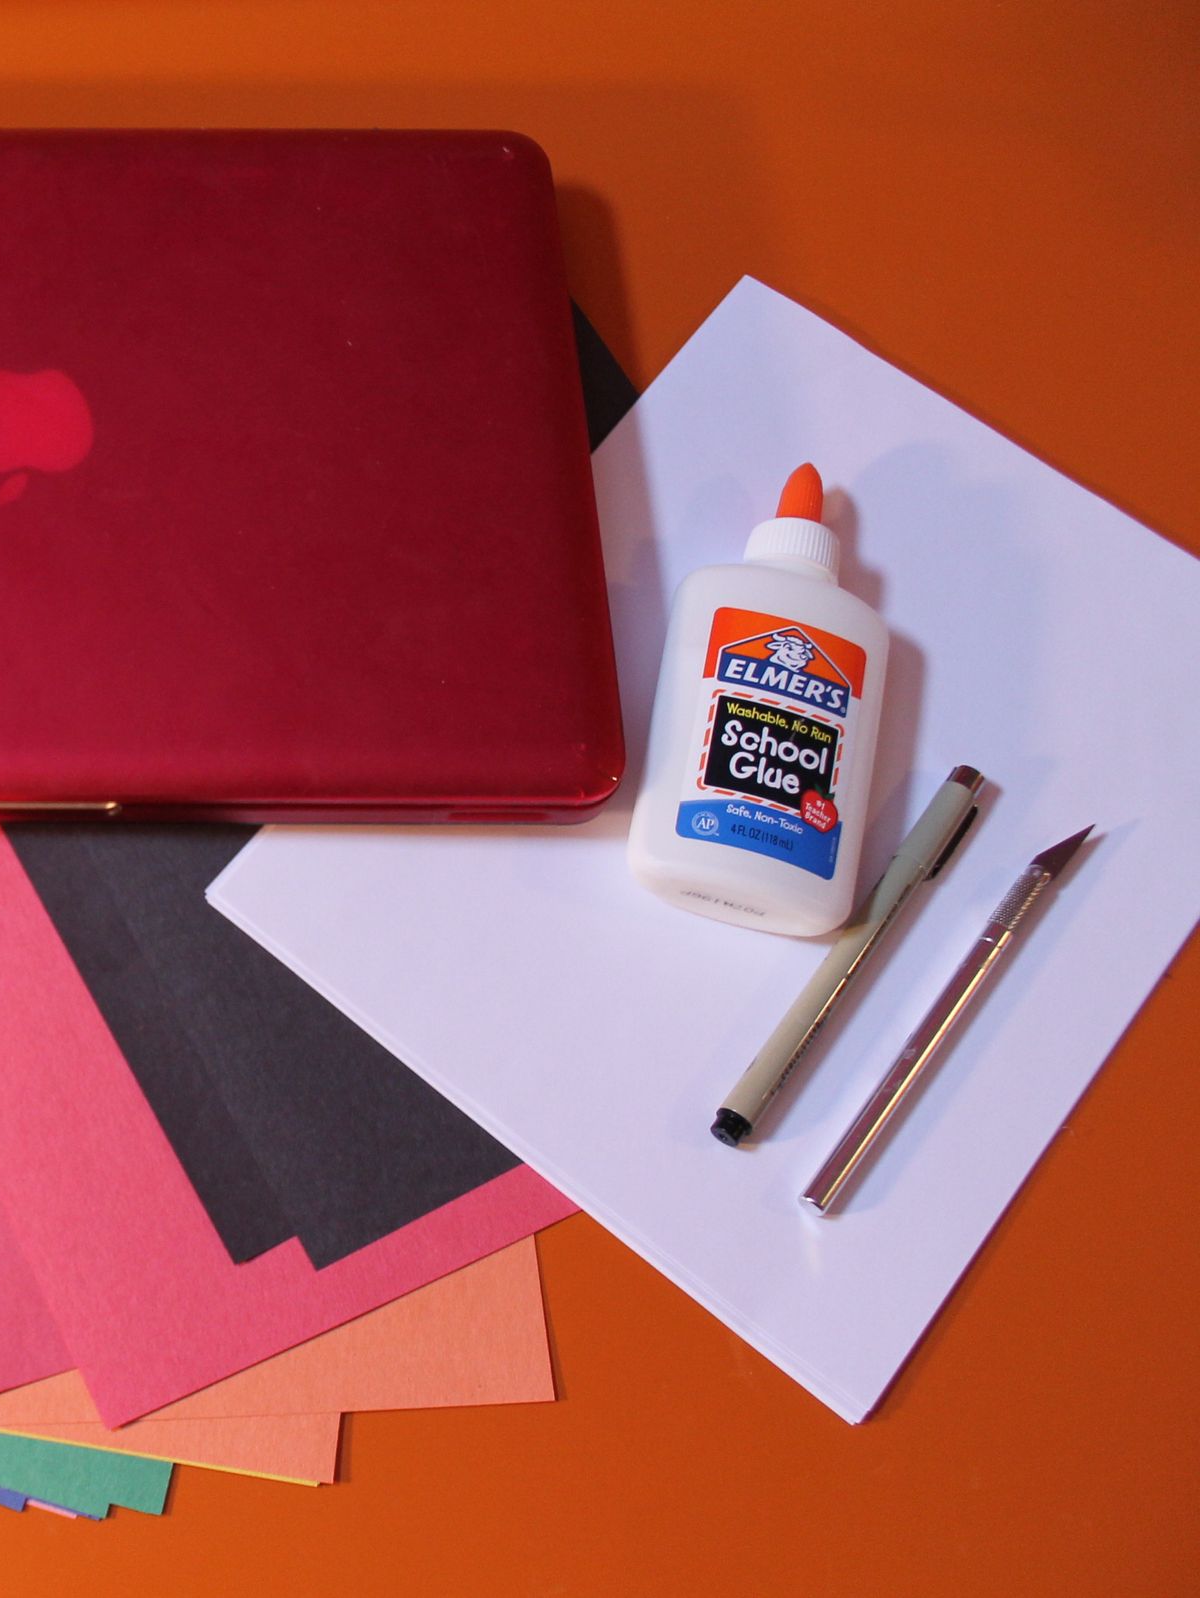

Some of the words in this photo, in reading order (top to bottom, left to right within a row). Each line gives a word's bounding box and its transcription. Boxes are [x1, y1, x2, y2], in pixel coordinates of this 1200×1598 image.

[725, 658, 845, 709] ELMER'S
[791, 719, 808, 735] No
[810, 726, 832, 744] Run
[721, 719, 828, 775] School
[729, 751, 800, 794] Glue
[754, 810, 804, 834] Non-Toxic
[804, 812, 827, 830] Brand
[805, 802, 832, 823] Teacher
[738, 824, 747, 837] FL
